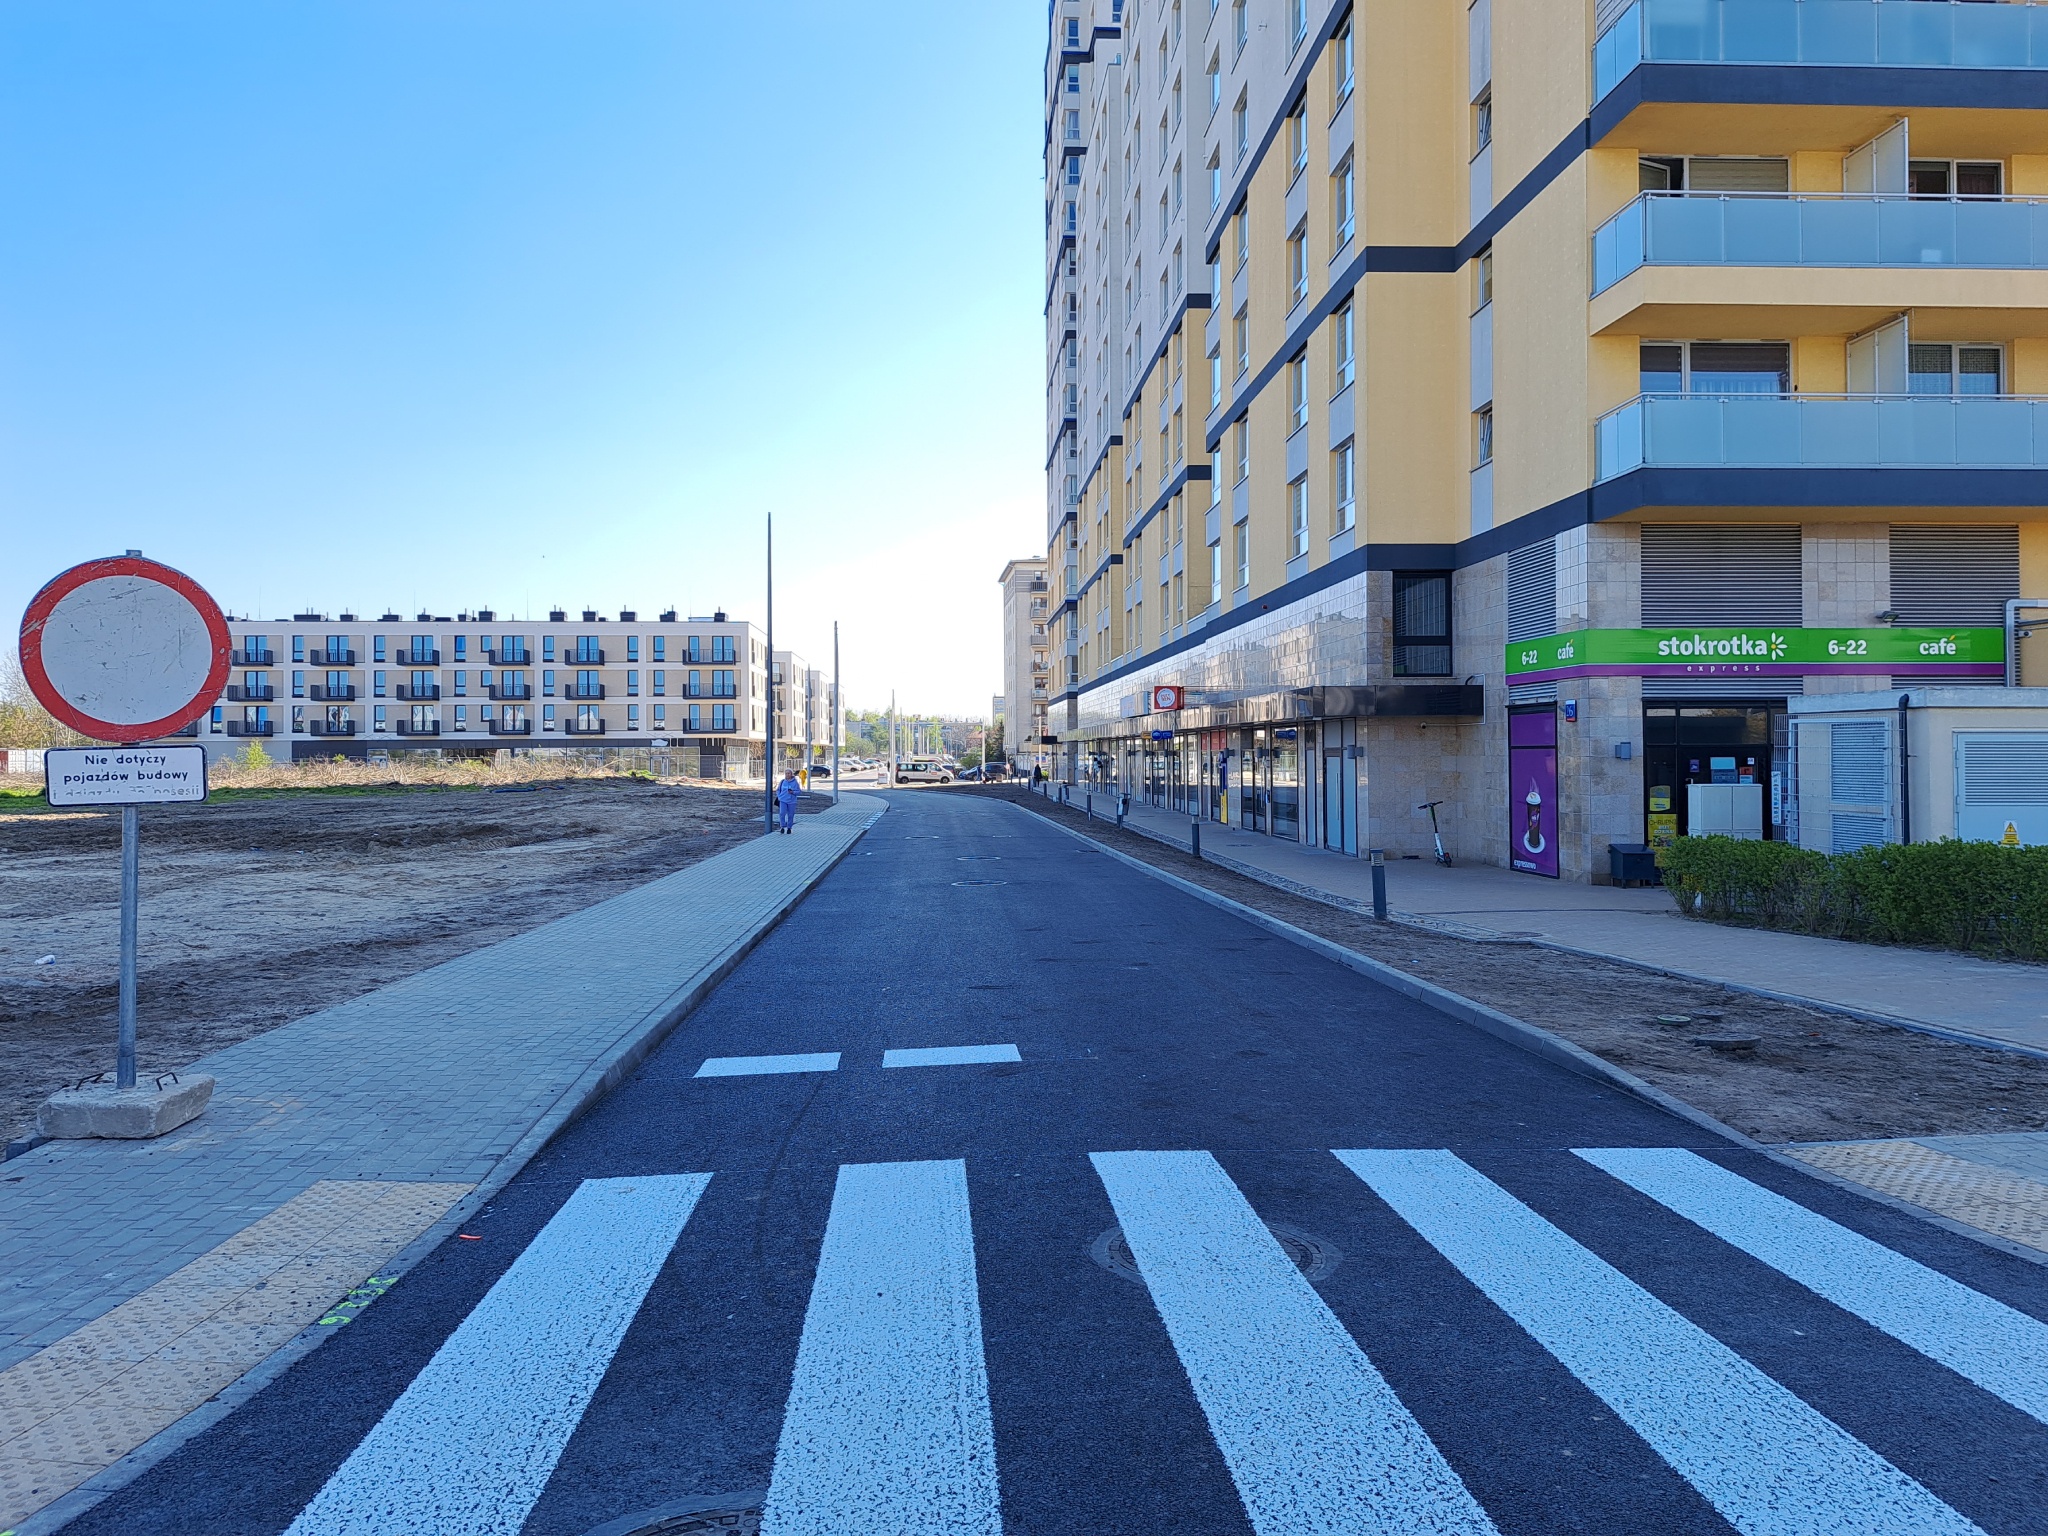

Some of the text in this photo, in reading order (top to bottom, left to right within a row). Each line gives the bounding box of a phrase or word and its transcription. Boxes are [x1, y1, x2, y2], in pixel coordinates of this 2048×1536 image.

[1521, 639, 1574, 665] 6-22 café
[1658, 634, 1957, 656] stokrotka 6-22 café
[1687, 665, 1760, 673] express
[85, 754, 166, 766] Nie dotyczy
[64, 770, 188, 785] pojazdów budowy
